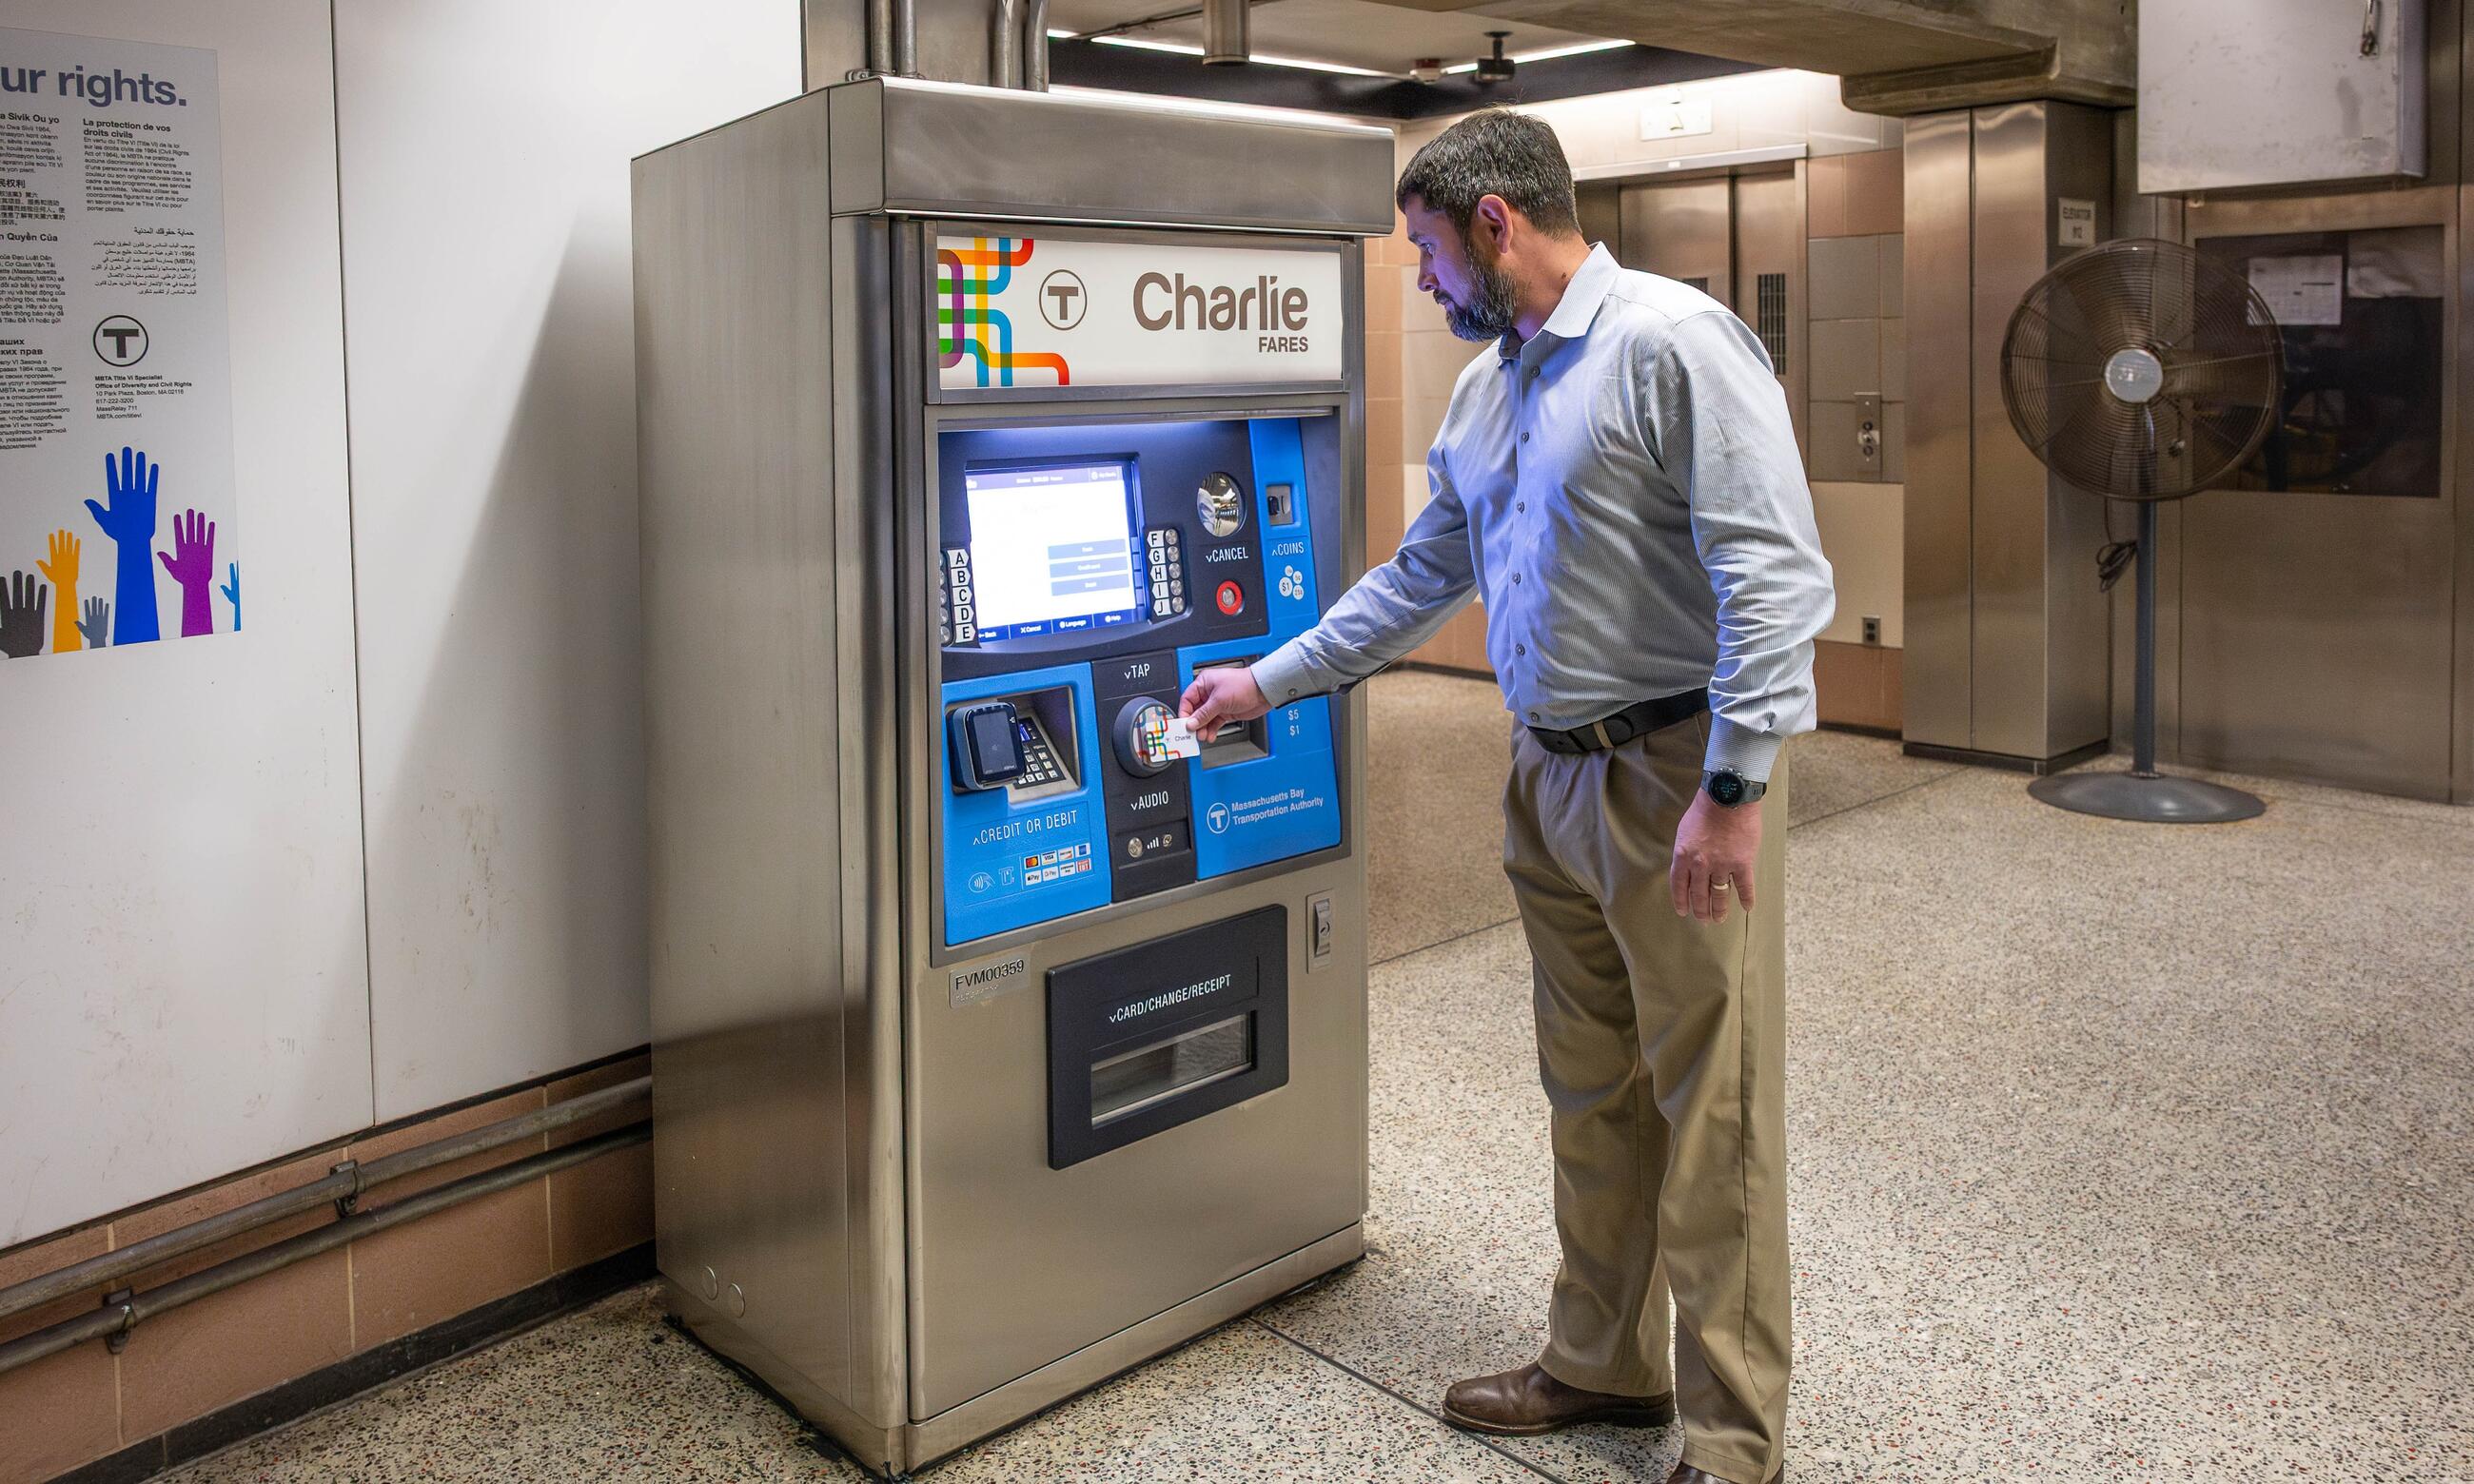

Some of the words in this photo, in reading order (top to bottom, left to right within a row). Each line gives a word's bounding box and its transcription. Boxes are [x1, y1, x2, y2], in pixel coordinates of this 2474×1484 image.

[59, 65, 187, 107] rights.
[9, 112, 30, 121] Sivik
[96, 120, 141, 129] protection
[84, 128, 108, 137] droits
[1047, 285, 1079, 321] T
[1132, 271, 1308, 332] Charlie
[103, 328, 139, 358] T
[1258, 336, 1308, 353] FARES
[1151, 534, 1157, 545] F
[955, 552, 965, 565] A
[1153, 551, 1160, 562] G
[957, 571, 966, 583] B
[1154, 567, 1162, 579] H
[1158, 585, 1161, 596] I
[1282, 582, 1290, 592] $1
[959, 590, 967, 601] C
[1158, 601, 1163, 613] J
[961, 608, 969, 620] D
[962, 627, 970, 639] E
[1287, 709, 1299, 721] $5
[1289, 725, 1300, 736] $1
[1231, 791, 1288, 811] Massachusetts
[1290, 789, 1305, 799] Bay
[1232, 807, 1288, 826] Transportation
[1290, 797, 1324, 812] Authority
[1027, 816, 1041, 834] OR
[1047, 810, 1078, 830] DEBIT
[1210, 809, 1226, 829] T
[954, 959, 1025, 990] FVM00359
